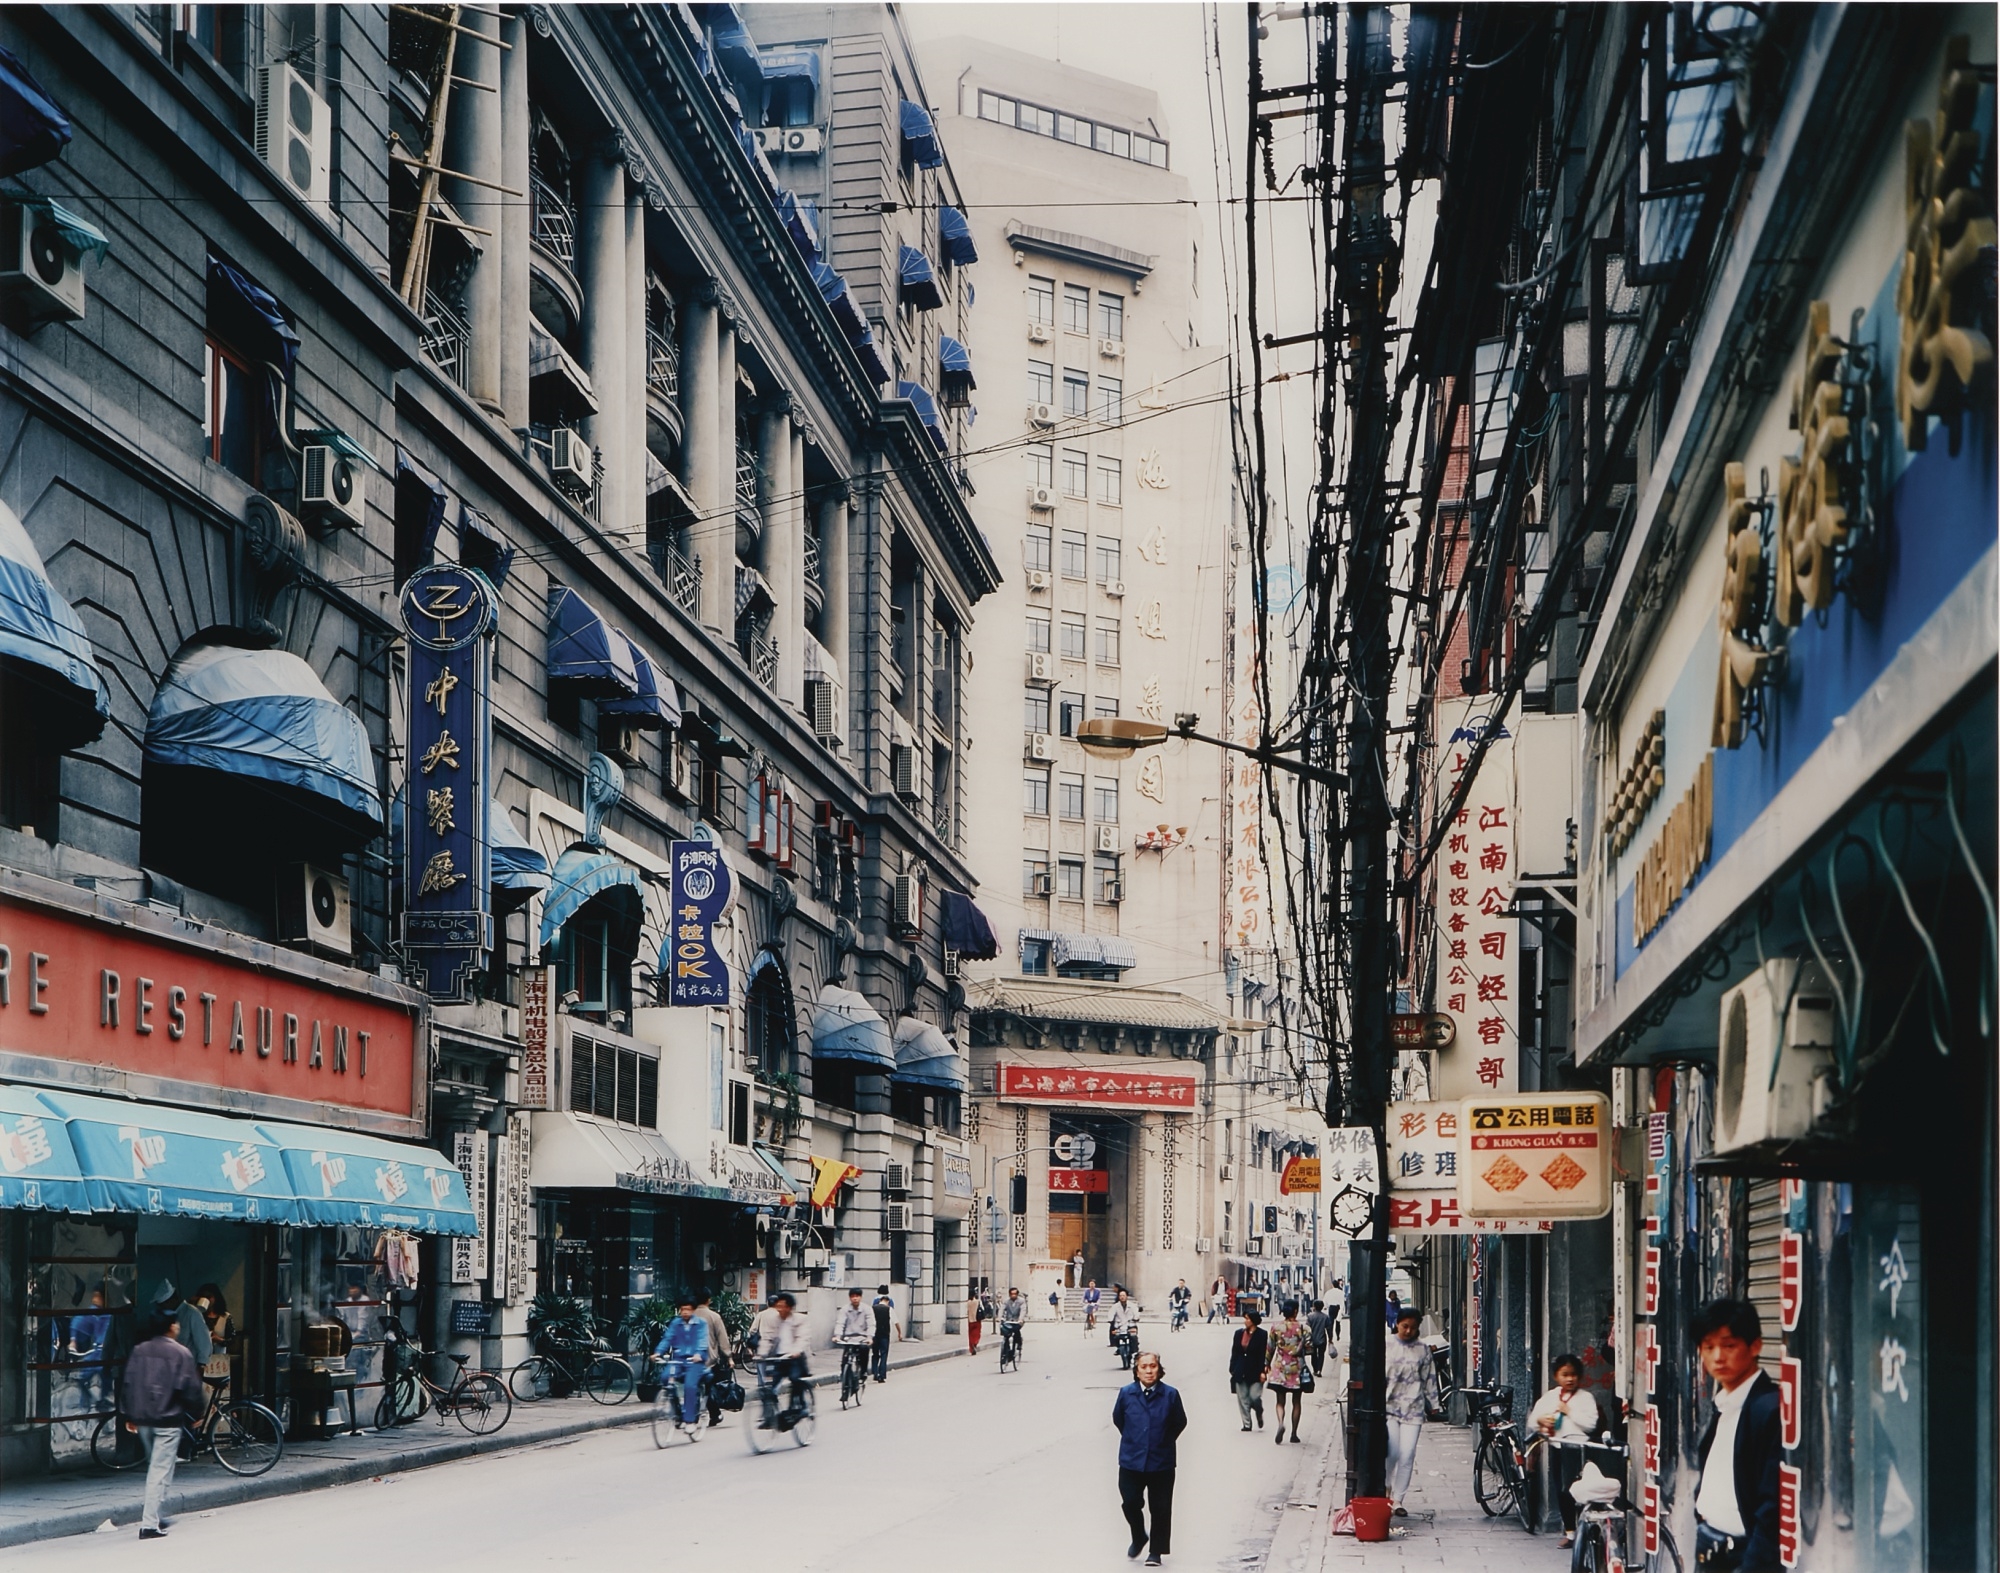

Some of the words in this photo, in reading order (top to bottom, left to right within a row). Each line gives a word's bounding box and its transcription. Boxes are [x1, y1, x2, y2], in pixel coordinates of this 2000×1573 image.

[678, 904, 713, 979] 卡拉OK
[1475, 804, 1510, 1089] 江南公司经营部
[100, 968, 372, 1078] RESTAURANT
[1399, 1112, 1457, 1139] 彩色
[1507, 1106, 1595, 1127] 公用電話
[118, 1126, 167, 1180] 7UP
[1329, 1129, 1376, 1154] 快修
[1493, 1138, 1532, 1148] KHONG
[311, 1150, 348, 1198] 7UP
[1332, 1158, 1375, 1183] 手表
[1398, 1150, 1457, 1178] 修理
[423, 1167, 451, 1209] 7UP
[1389, 1198, 1463, 1229] 名片
